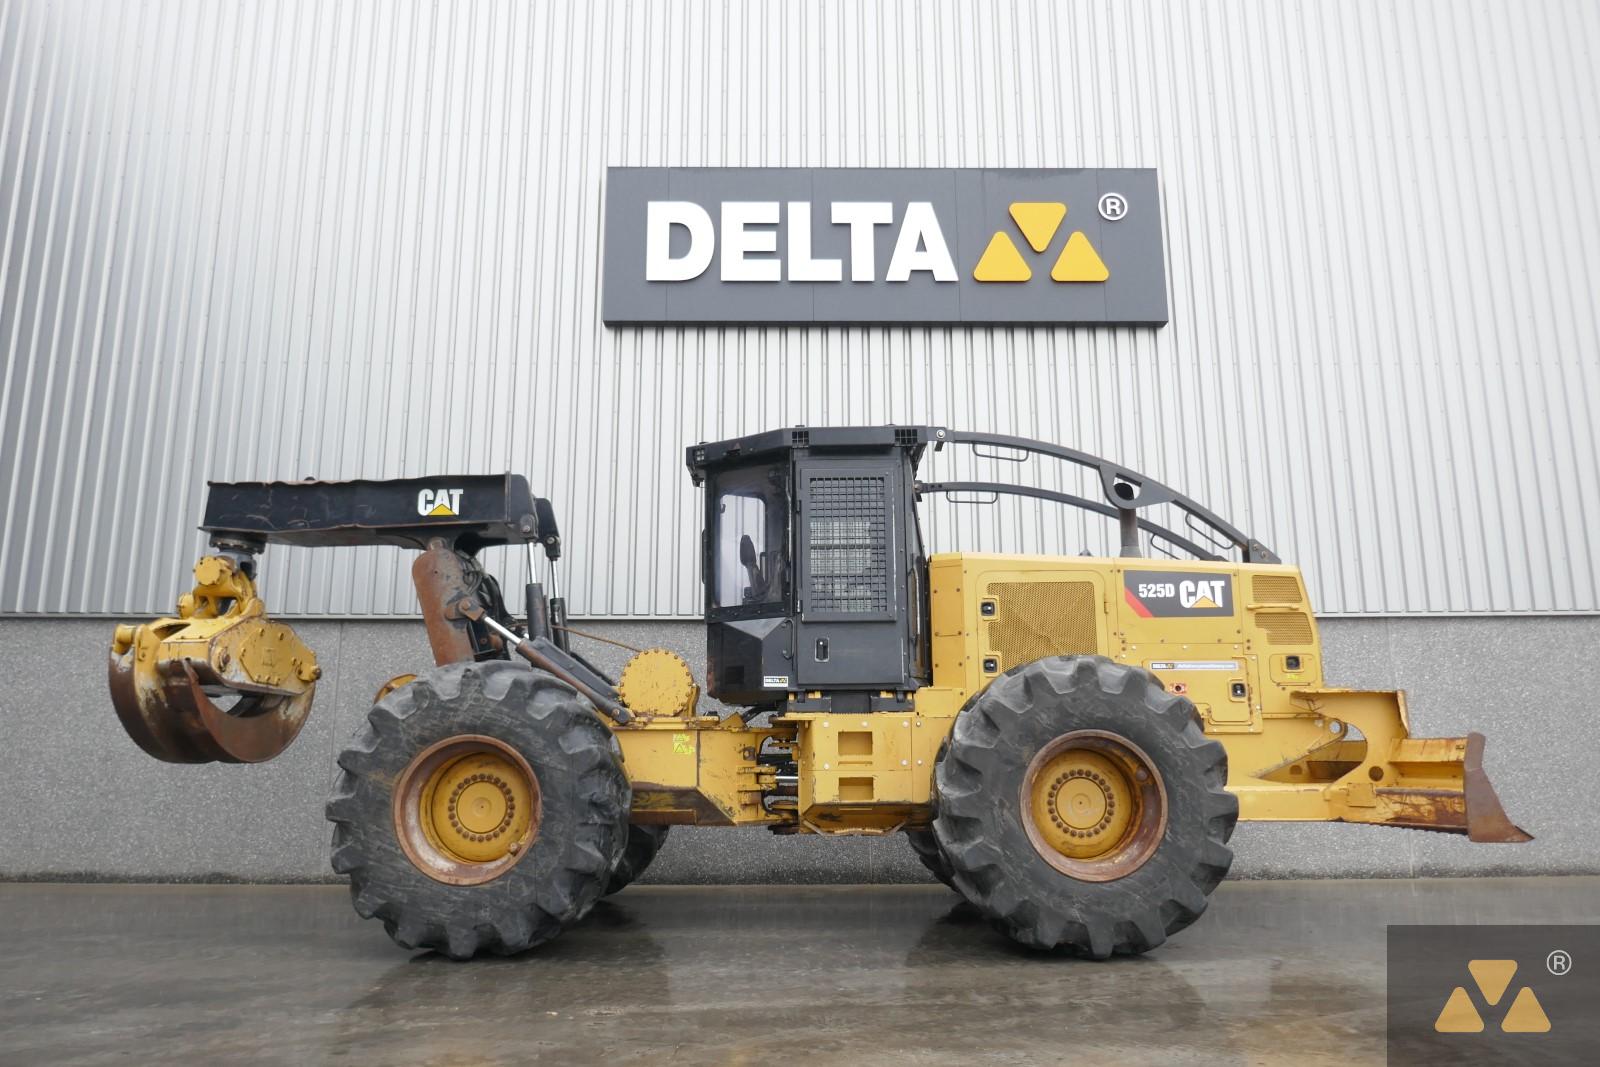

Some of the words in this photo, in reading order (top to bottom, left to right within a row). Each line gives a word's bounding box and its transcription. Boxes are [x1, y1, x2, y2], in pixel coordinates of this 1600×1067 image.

[645, 201, 959, 282] DELTA
[417, 488, 464, 516] CAT
[1138, 583, 1175, 598] 525D
[1179, 580, 1225, 608] CAT
